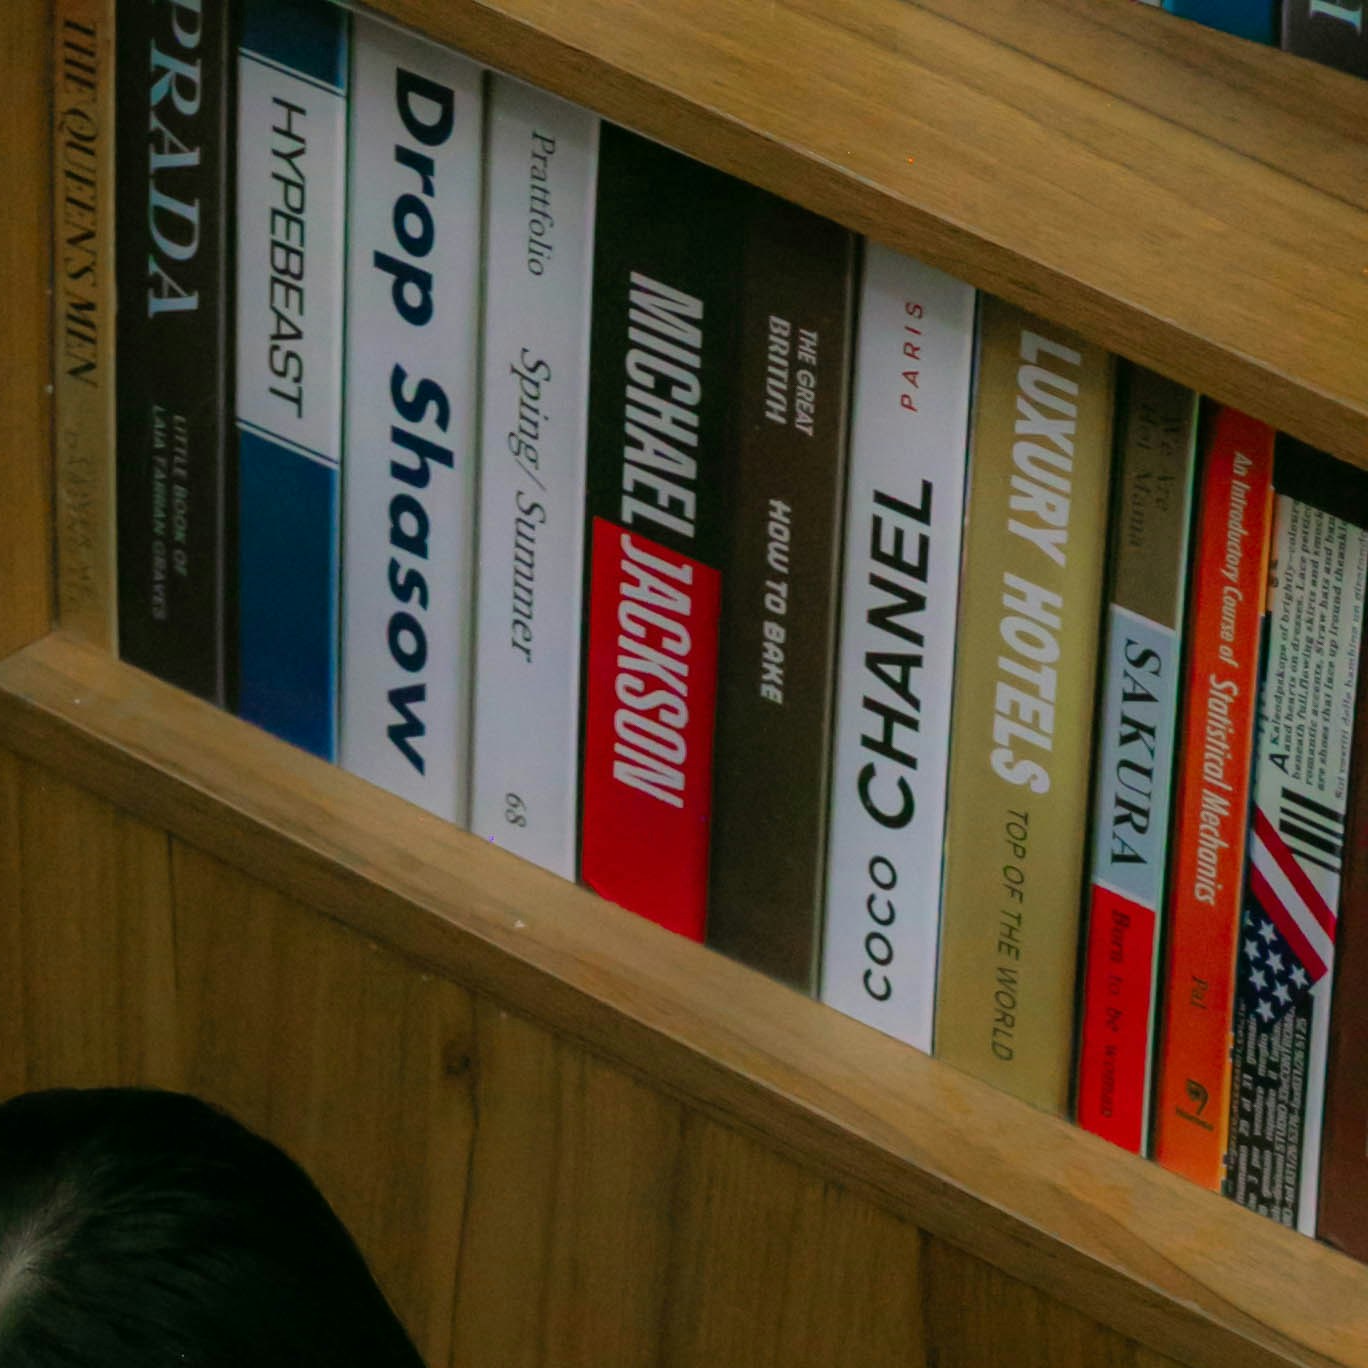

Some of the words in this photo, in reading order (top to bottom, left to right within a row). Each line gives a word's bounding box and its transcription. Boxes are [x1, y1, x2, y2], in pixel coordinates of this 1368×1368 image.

[62, 19, 98, 99] THE
[149, 0, 202, 318] PRADA
[372, 67, 457, 328] Drop
[527, 130, 557, 276] Prattfolio
[269, 97, 307, 417] HYPEBEAST
[63, 292, 98, 388] MEN
[766, 316, 790, 425] BRITISH
[795, 329, 818, 368] THE
[900, 301, 925, 411] PARIS
[171, 415, 189, 479] LITTLE
[621, 271, 704, 539] MICHAEL
[792, 369, 817, 436] GREAT
[1007, 329, 1082, 565] LUXURY
[1232, 451, 1252, 477] An
[171, 484, 188, 544] BOOK
[768, 499, 790, 571] HOW
[1218, 479, 1251, 583] Introductory
[173, 549, 187, 576] OF
[386, 364, 455, 776] Shasow
[511, 492, 547, 663] Summer
[766, 574, 787, 616] TO
[857, 479, 933, 831] CHANEL
[1218, 644, 1239, 668] of
[1220, 586, 1242, 642] Course
[612, 533, 694, 808] JACKSON
[760, 621, 784, 705] BAKE
[990, 569, 1062, 795] HOTELS
[1110, 638, 1164, 866] SAKURA
[1201, 673, 1238, 790] Statistical
[1267, 753, 1289, 774] A
[504, 793, 527, 828] 68
[1006, 808, 1029, 858] TOP
[1192, 789, 1230, 906] Mechanics
[863, 855, 899, 1003] COCO
[1002, 864, 1025, 903] OF
[998, 909, 1024, 962] THE
[1108, 909, 1130, 964] Born
[990, 966, 1021, 1062] WORLD
